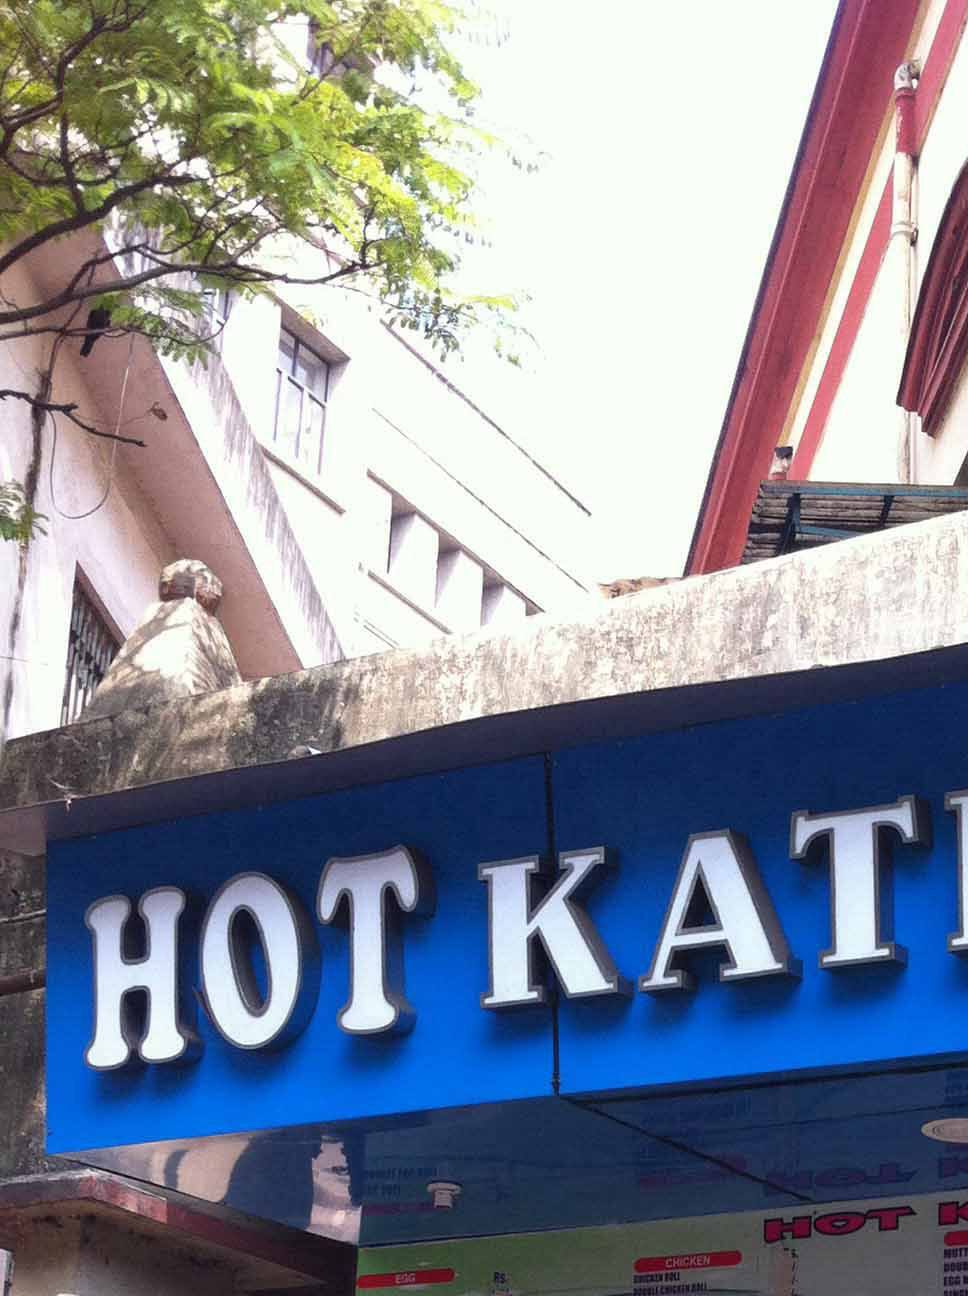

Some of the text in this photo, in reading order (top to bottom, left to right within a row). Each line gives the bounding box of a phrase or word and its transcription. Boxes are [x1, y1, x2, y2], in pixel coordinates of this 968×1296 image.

[85, 845, 435, 1070] HOT
[764, 1207, 916, 1243] HOT
[665, 1256, 710, 1268] CHICKEN
[395, 1273, 416, 1285] EGG
[944, 1276, 960, 1286] EGG
